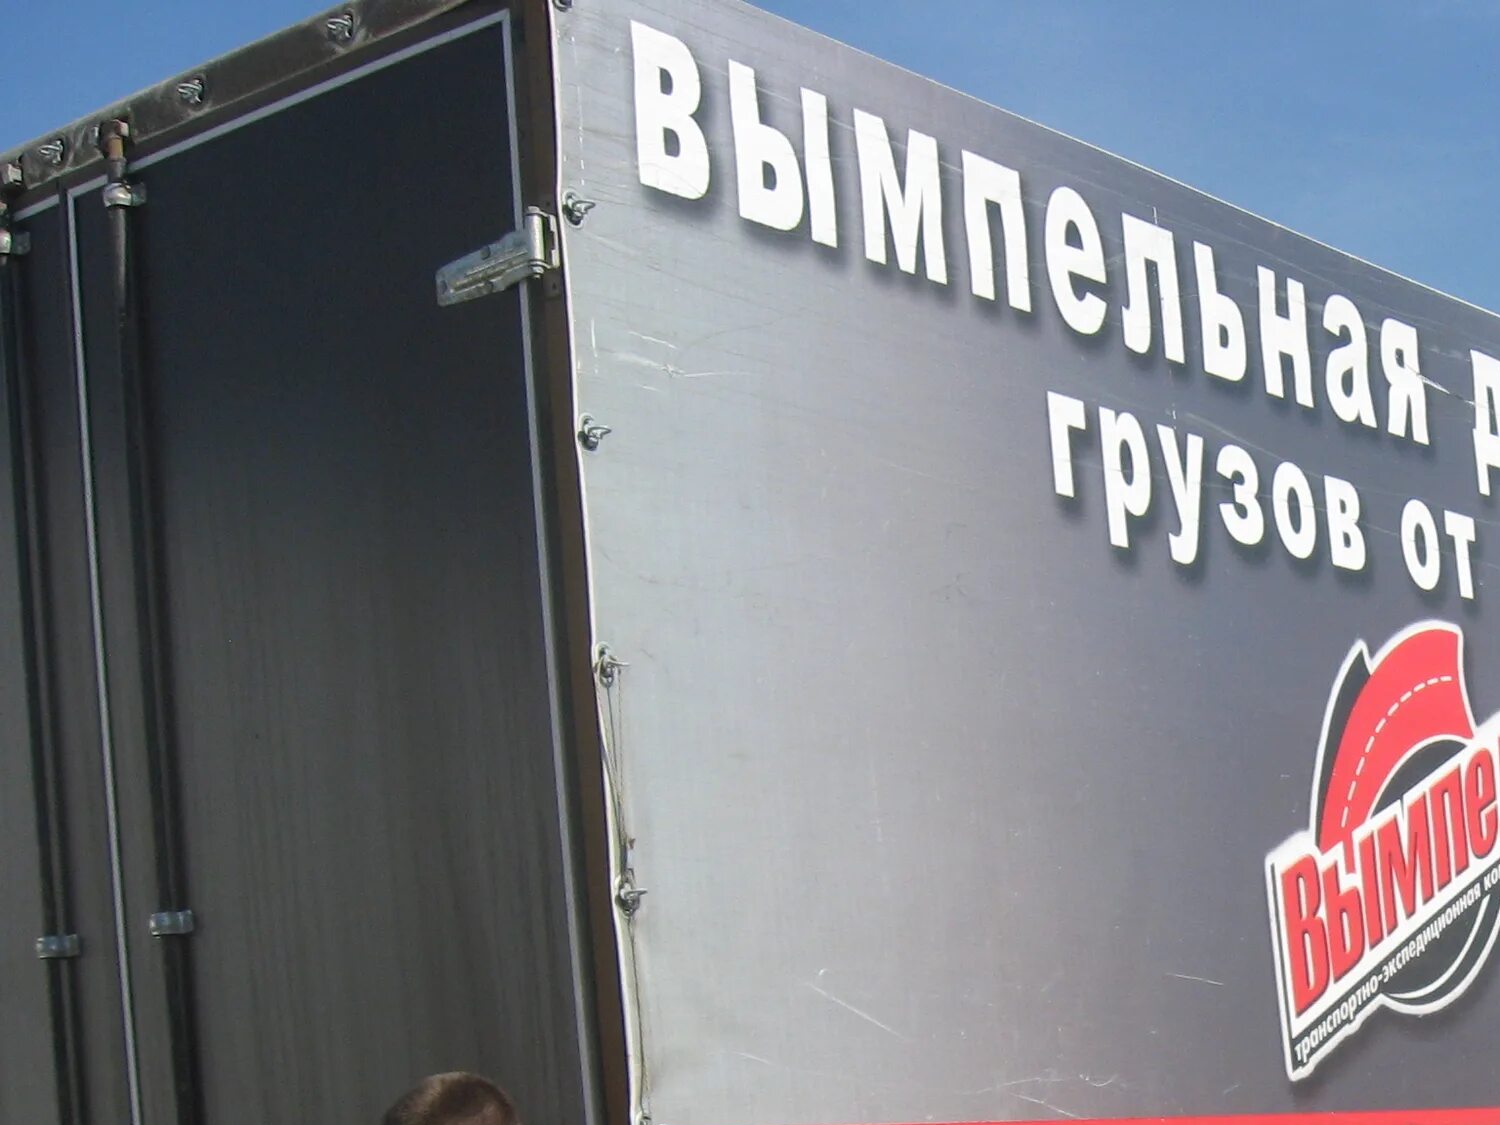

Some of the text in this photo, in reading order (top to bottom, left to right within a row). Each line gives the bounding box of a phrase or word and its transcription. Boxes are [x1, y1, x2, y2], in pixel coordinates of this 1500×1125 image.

[1046, 391, 1367, 565] грузов
[1401, 498, 1476, 600] от
[1294, 882, 1482, 1064] транспортно-экспедиционная
